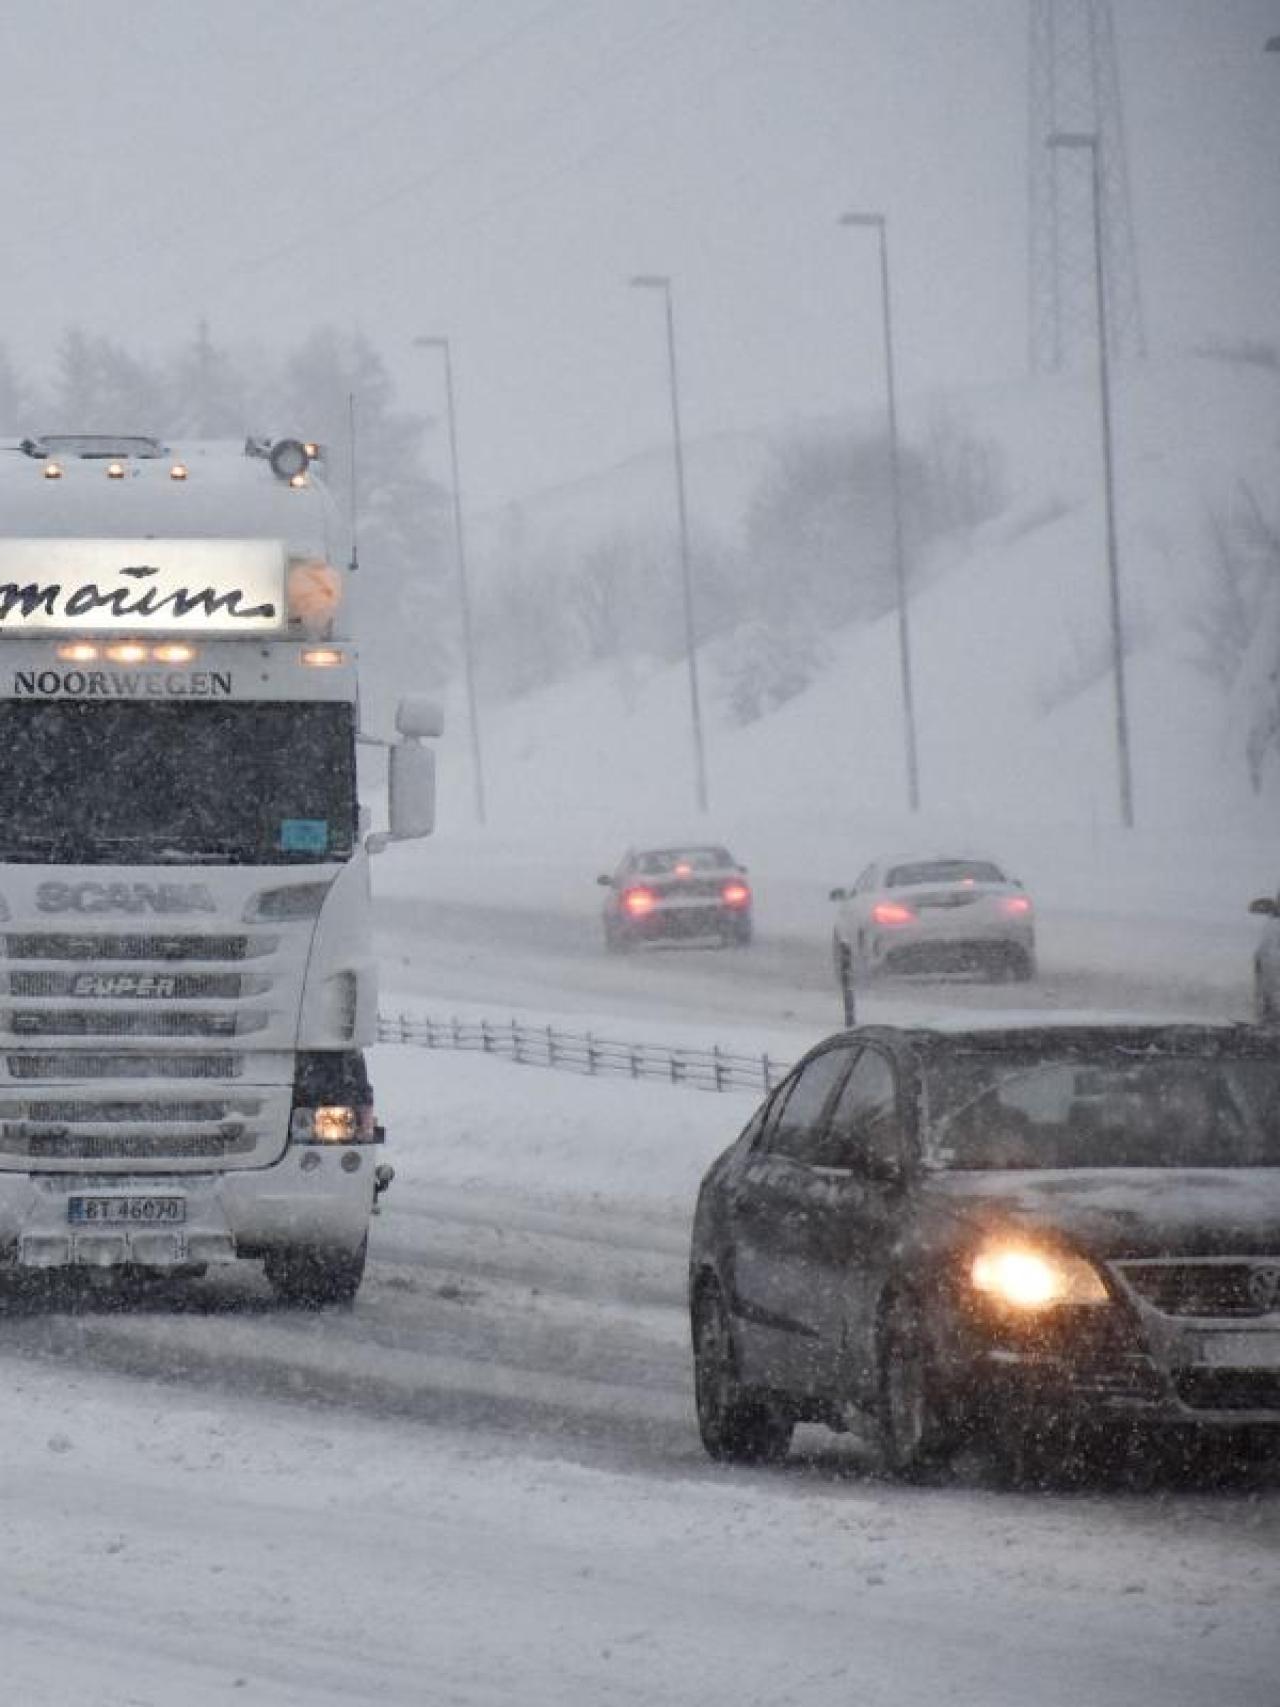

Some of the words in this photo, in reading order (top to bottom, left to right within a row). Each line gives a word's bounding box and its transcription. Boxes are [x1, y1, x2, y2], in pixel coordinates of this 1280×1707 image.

[13, 670, 233, 696] NOORWEGEN
[34, 881, 218, 914] SCANIA
[73, 972, 177, 997] SUPER
